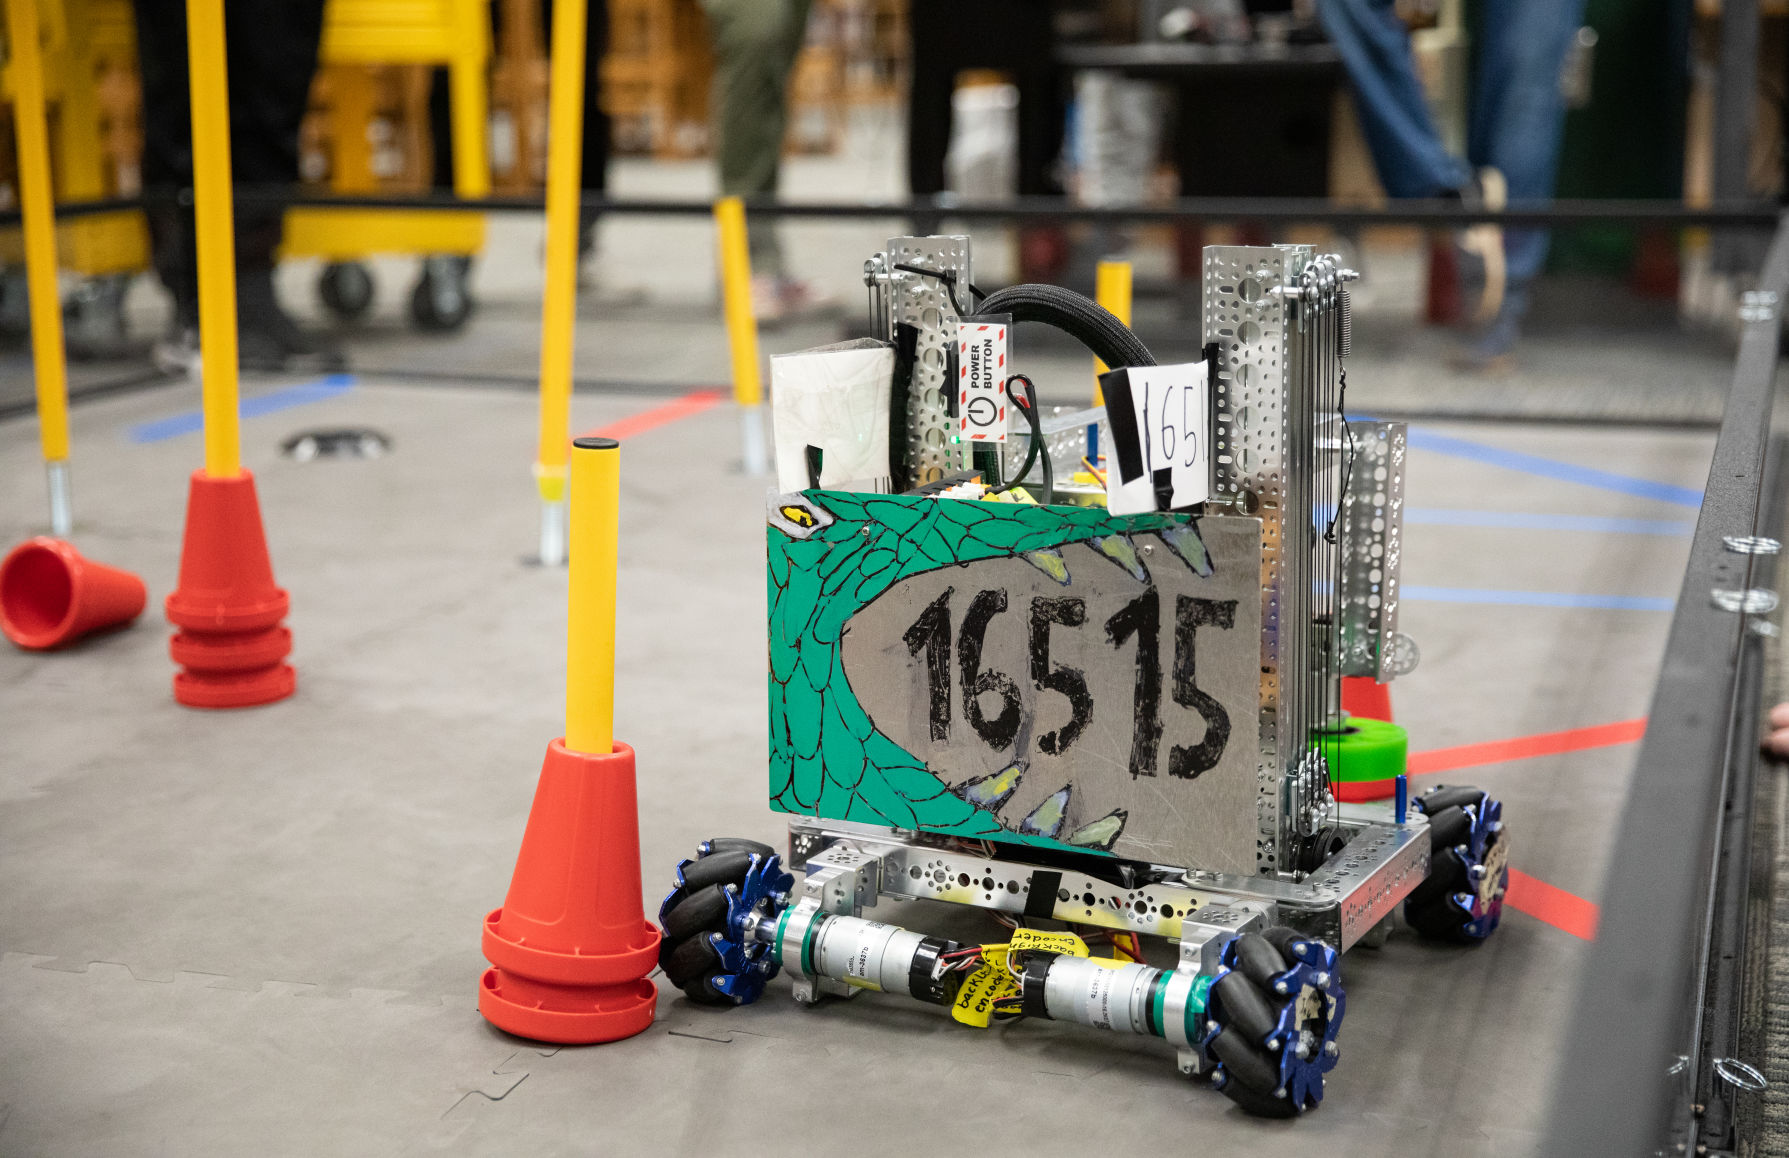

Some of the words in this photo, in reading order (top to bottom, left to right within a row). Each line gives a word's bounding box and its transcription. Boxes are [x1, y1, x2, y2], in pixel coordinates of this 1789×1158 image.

[970, 345, 980, 389] POWER
[983, 339, 993, 389] BUTTON
[903, 585, 1239, 780] 16515
